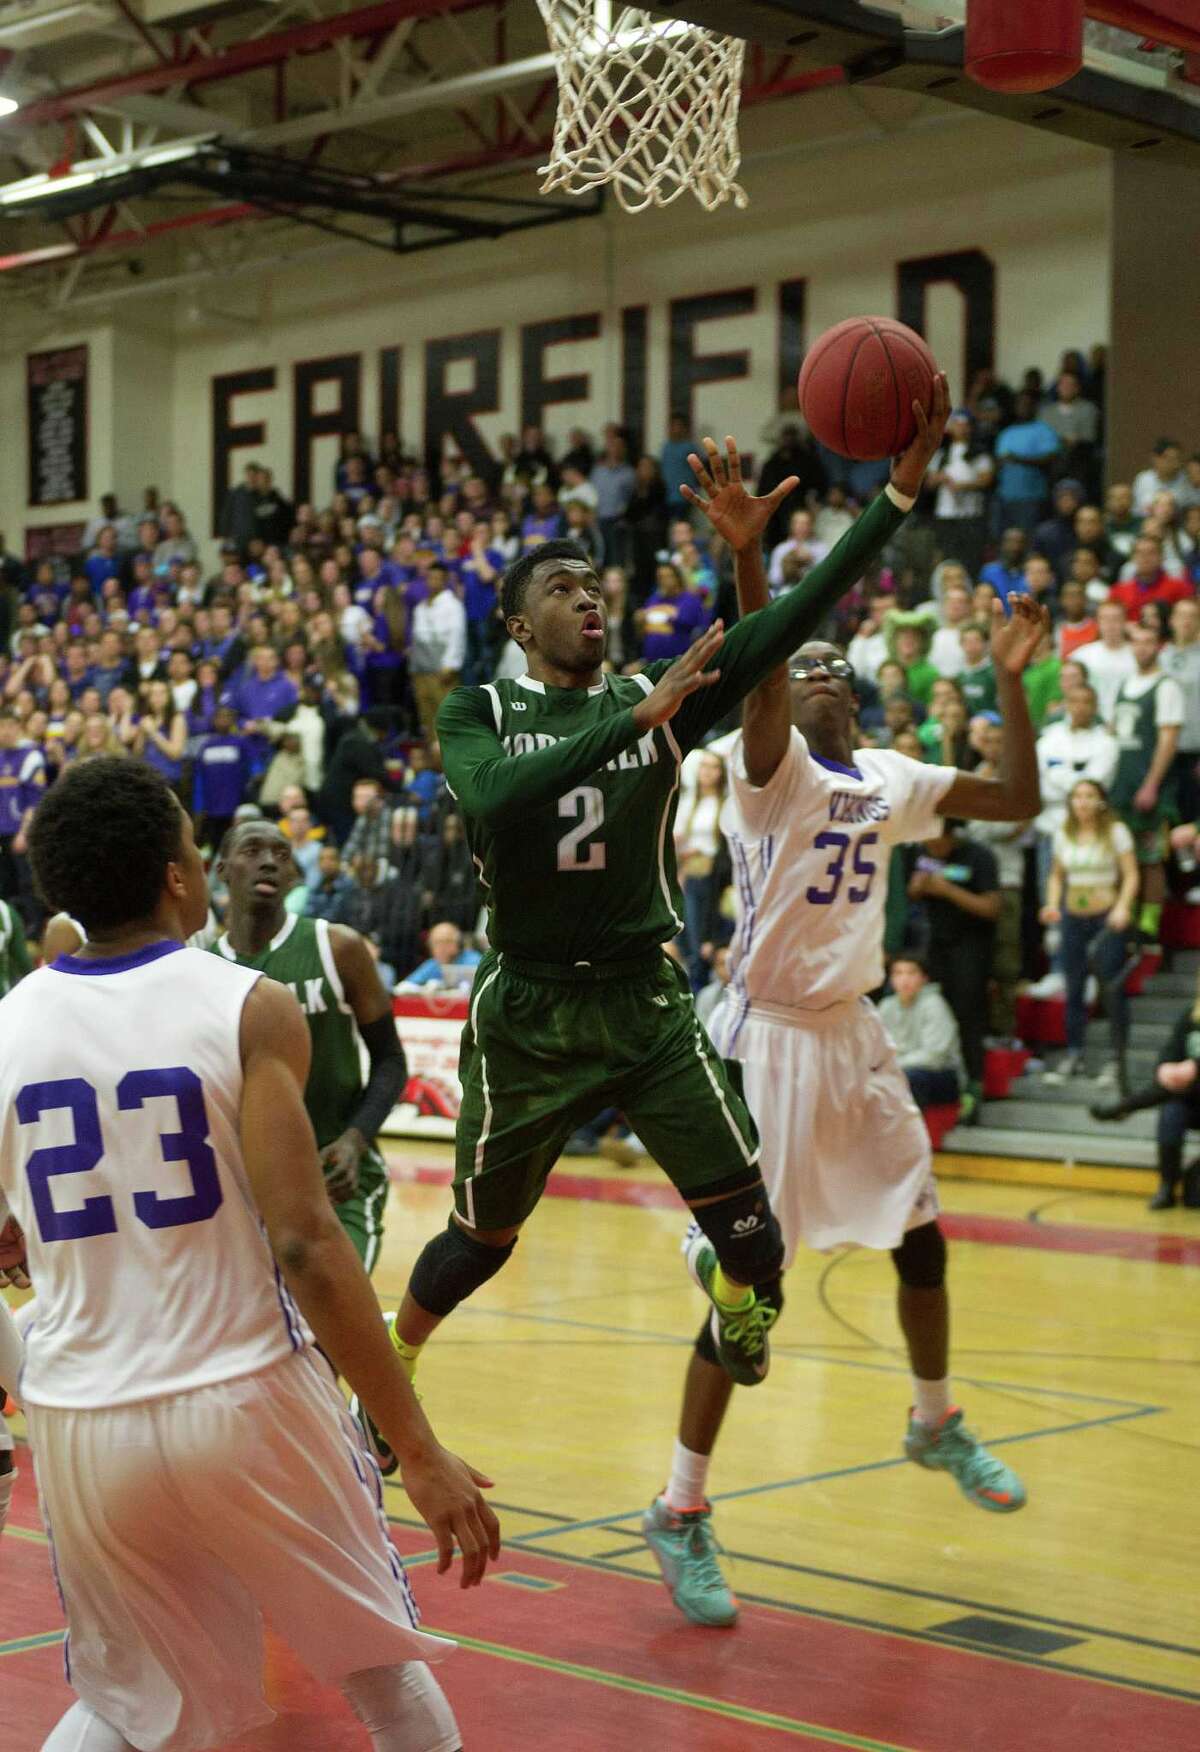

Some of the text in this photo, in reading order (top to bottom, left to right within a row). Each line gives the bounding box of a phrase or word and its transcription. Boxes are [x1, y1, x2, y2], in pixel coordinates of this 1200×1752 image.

[557, 786, 605, 871] 2
[806, 832, 878, 904] 35
[15, 1066, 223, 1242] 23
